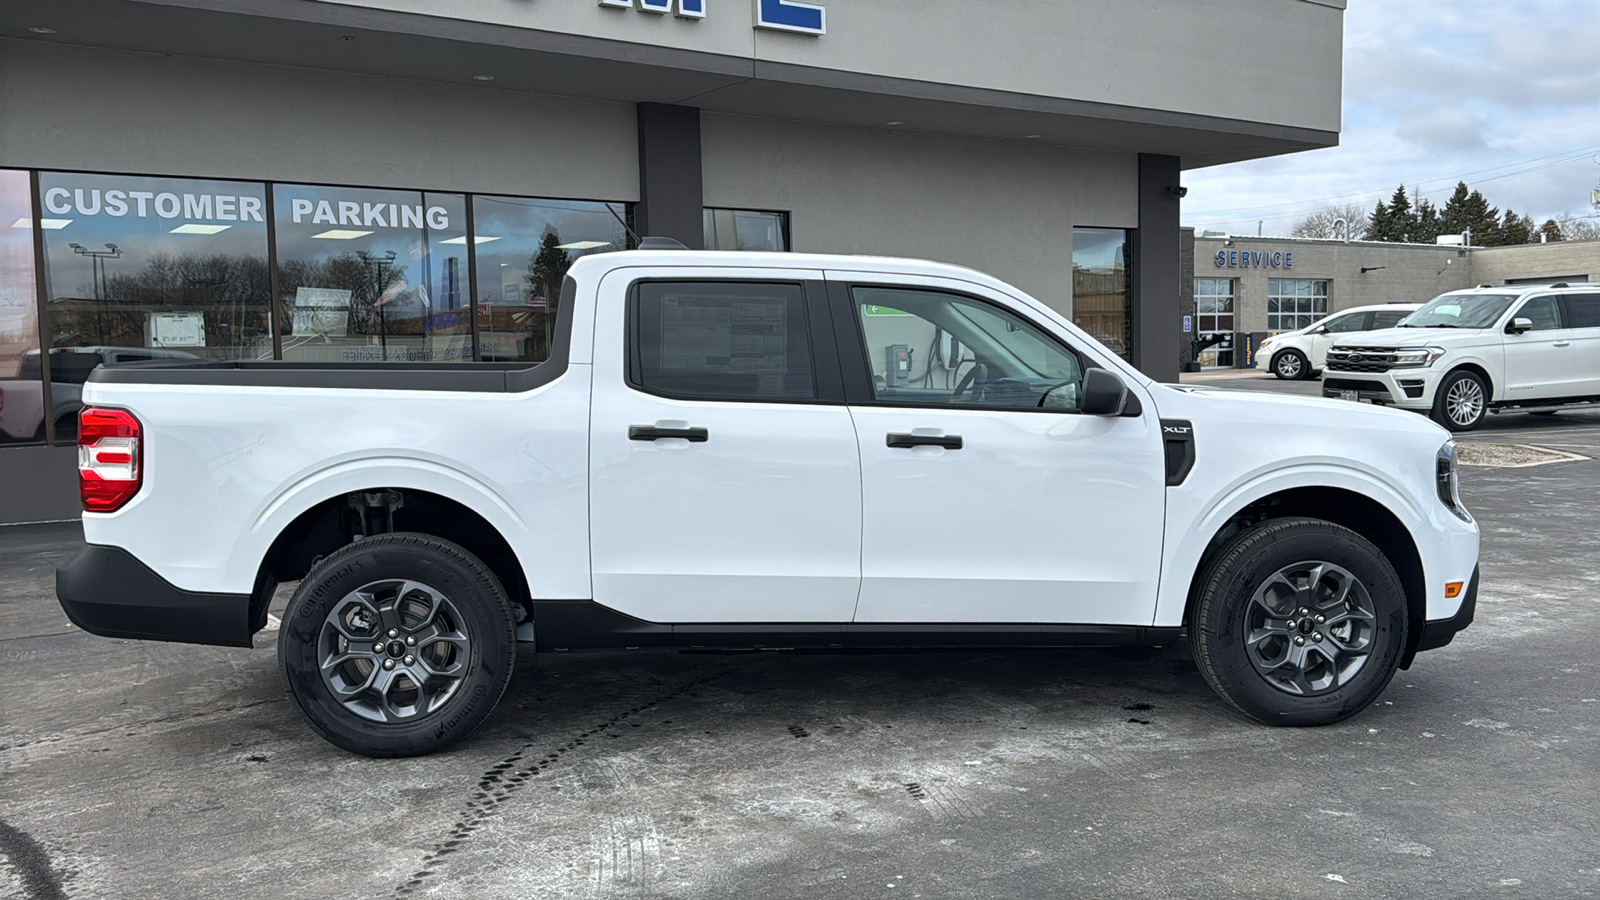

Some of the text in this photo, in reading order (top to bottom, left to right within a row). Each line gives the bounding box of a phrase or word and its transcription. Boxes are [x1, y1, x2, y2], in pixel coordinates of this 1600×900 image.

[44, 187, 450, 230] CUSTOMER PARKING
[1215, 249, 1295, 269] SERVICE
[299, 563, 354, 619] Continental
